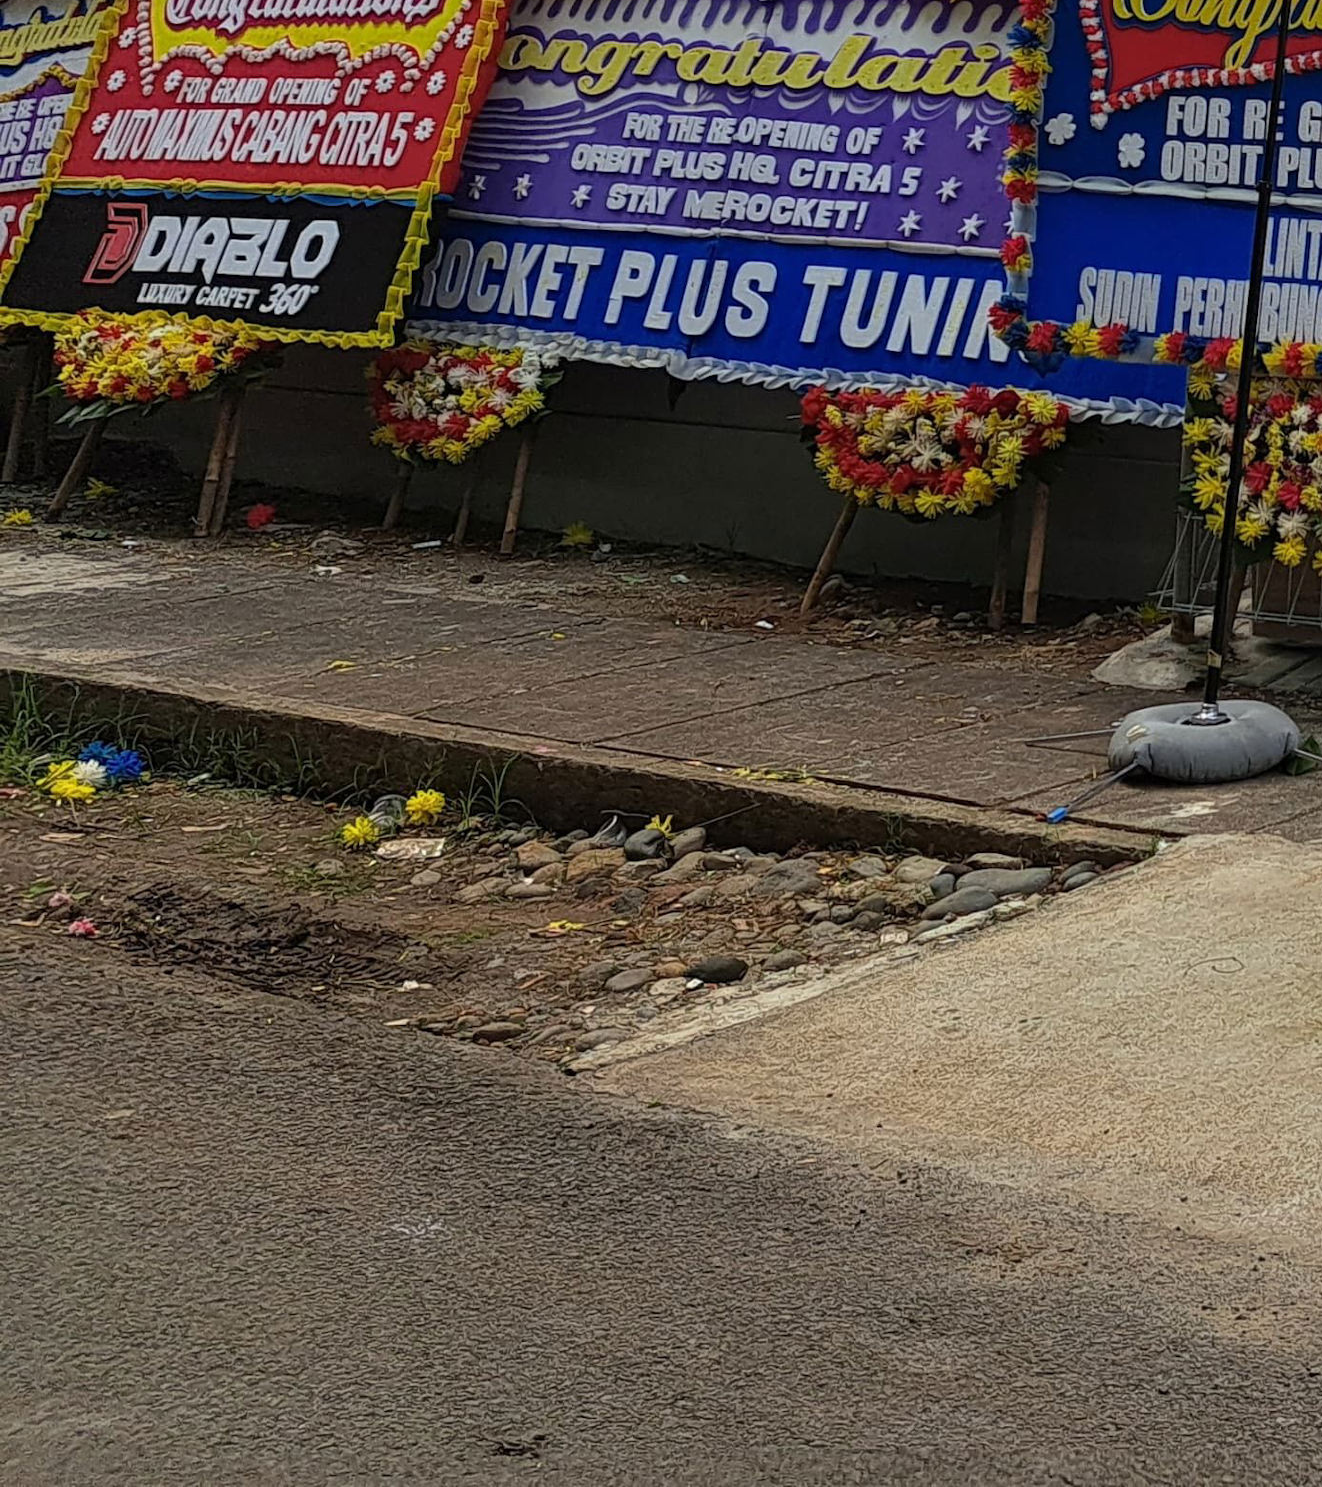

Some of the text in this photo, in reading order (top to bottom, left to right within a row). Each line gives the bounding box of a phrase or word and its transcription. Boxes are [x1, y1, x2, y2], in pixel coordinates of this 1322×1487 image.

[176, 76, 371, 106] FOR GRAND OPENING OF
[231, 110, 328, 164] CABANG
[320, 111, 390, 166] CITRA
[386, 112, 416, 167] 5
[623, 112, 663, 141] FOR
[666, 114, 704, 144] THE
[845, 126, 882, 155] OF
[1165, 94, 1232, 139] FOR
[570, 143, 651, 175] ORBIT
[652, 148, 727, 181] PLUS
[788, 158, 893, 193] CITRA
[898, 166, 922, 196] 5
[1160, 140, 1264, 186] ORBIT
[606, 182, 677, 216] STAY
[131, 215, 340, 284] DIABLO
[136, 283, 197, 305] LUXURY
[196, 285, 260, 310] CARPET
[603, 249, 778, 339] PLUS
[799, 265, 1014, 363] TUNIN
[1076, 266, 1162, 334] SUDIN
